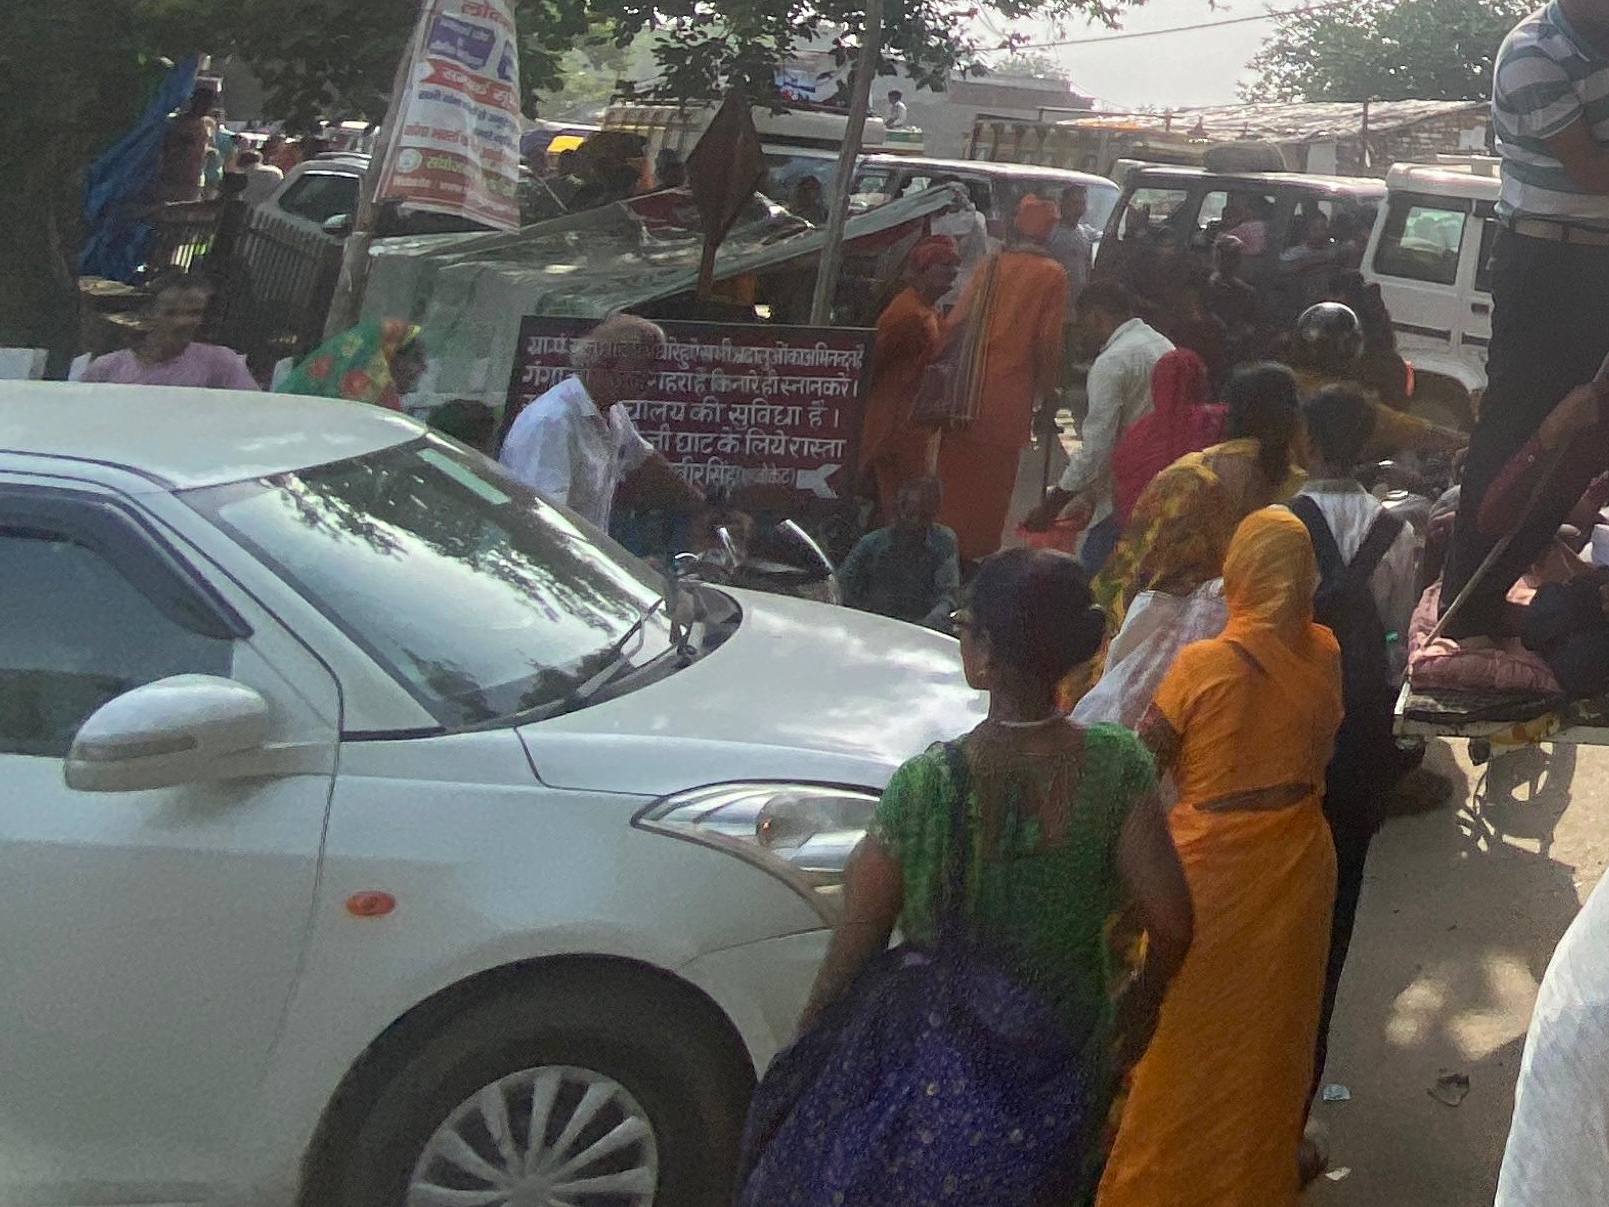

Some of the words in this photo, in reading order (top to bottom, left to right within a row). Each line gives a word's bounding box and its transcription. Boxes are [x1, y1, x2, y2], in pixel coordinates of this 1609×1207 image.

[689, 395, 727, 424] की
[728, 397, 803, 432] सुविधा
[675, 430, 716, 453] घाट
[715, 425, 742, 454] के
[745, 427, 791, 457] लिये
[789, 436, 848, 459] रास्ता
